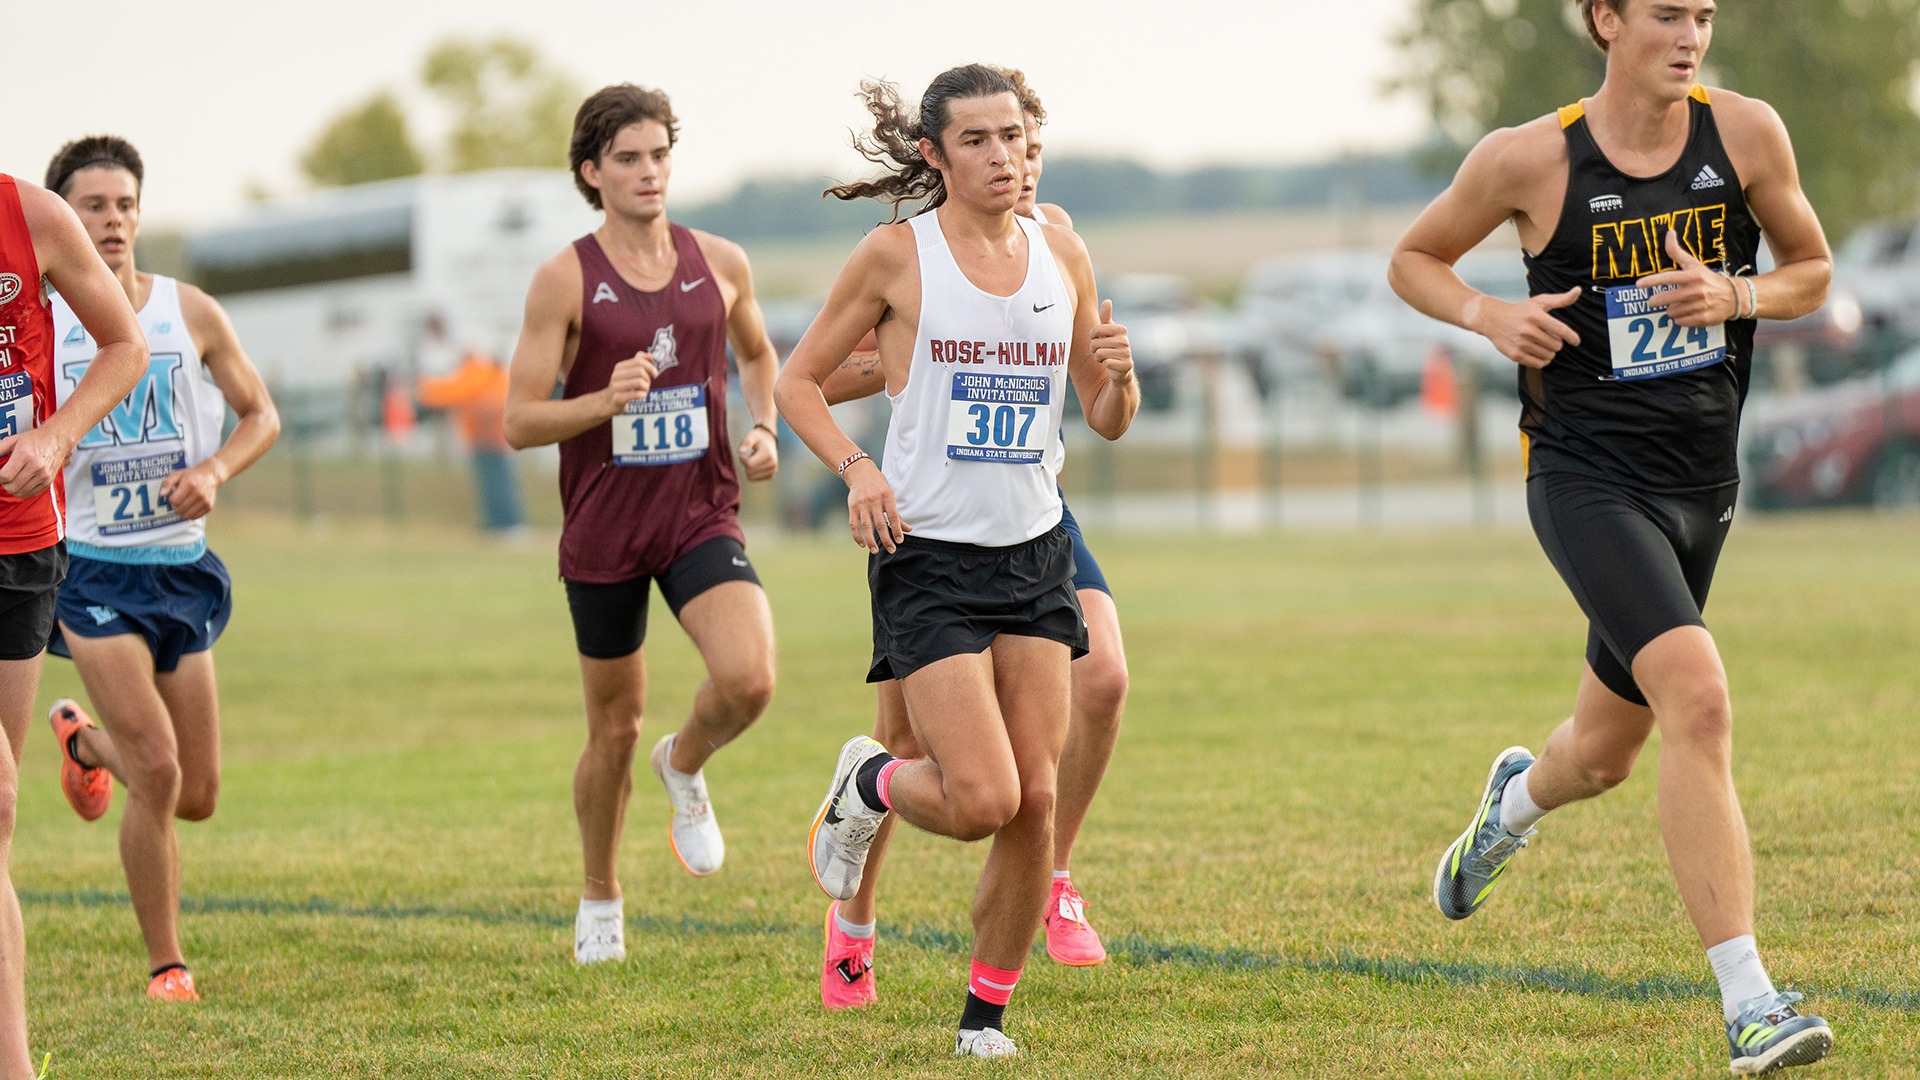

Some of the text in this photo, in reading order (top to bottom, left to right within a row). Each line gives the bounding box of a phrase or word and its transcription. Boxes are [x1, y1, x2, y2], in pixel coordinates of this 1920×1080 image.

[1690, 178, 1725, 191] adidas
[1590, 198, 1622, 209] HORIZON
[1592, 203, 1727, 280] MKE
[1615, 285, 1649, 303] JOHN
[1628, 314, 1708, 363] 224
[930, 339, 1066, 366] ROSE-HULMAN
[1622, 350, 1720, 378] INDIANA STATE UNIVERSITY
[961, 375, 1045, 390] JOHN McNICHOLS
[967, 388, 1040, 402] INVITATIONAL
[631, 414, 693, 451] 118
[966, 403, 1036, 447] 307
[956, 447, 984, 457] INDIANA
[986, 449, 1007, 459] STATE
[99, 461, 125, 475] JOHN
